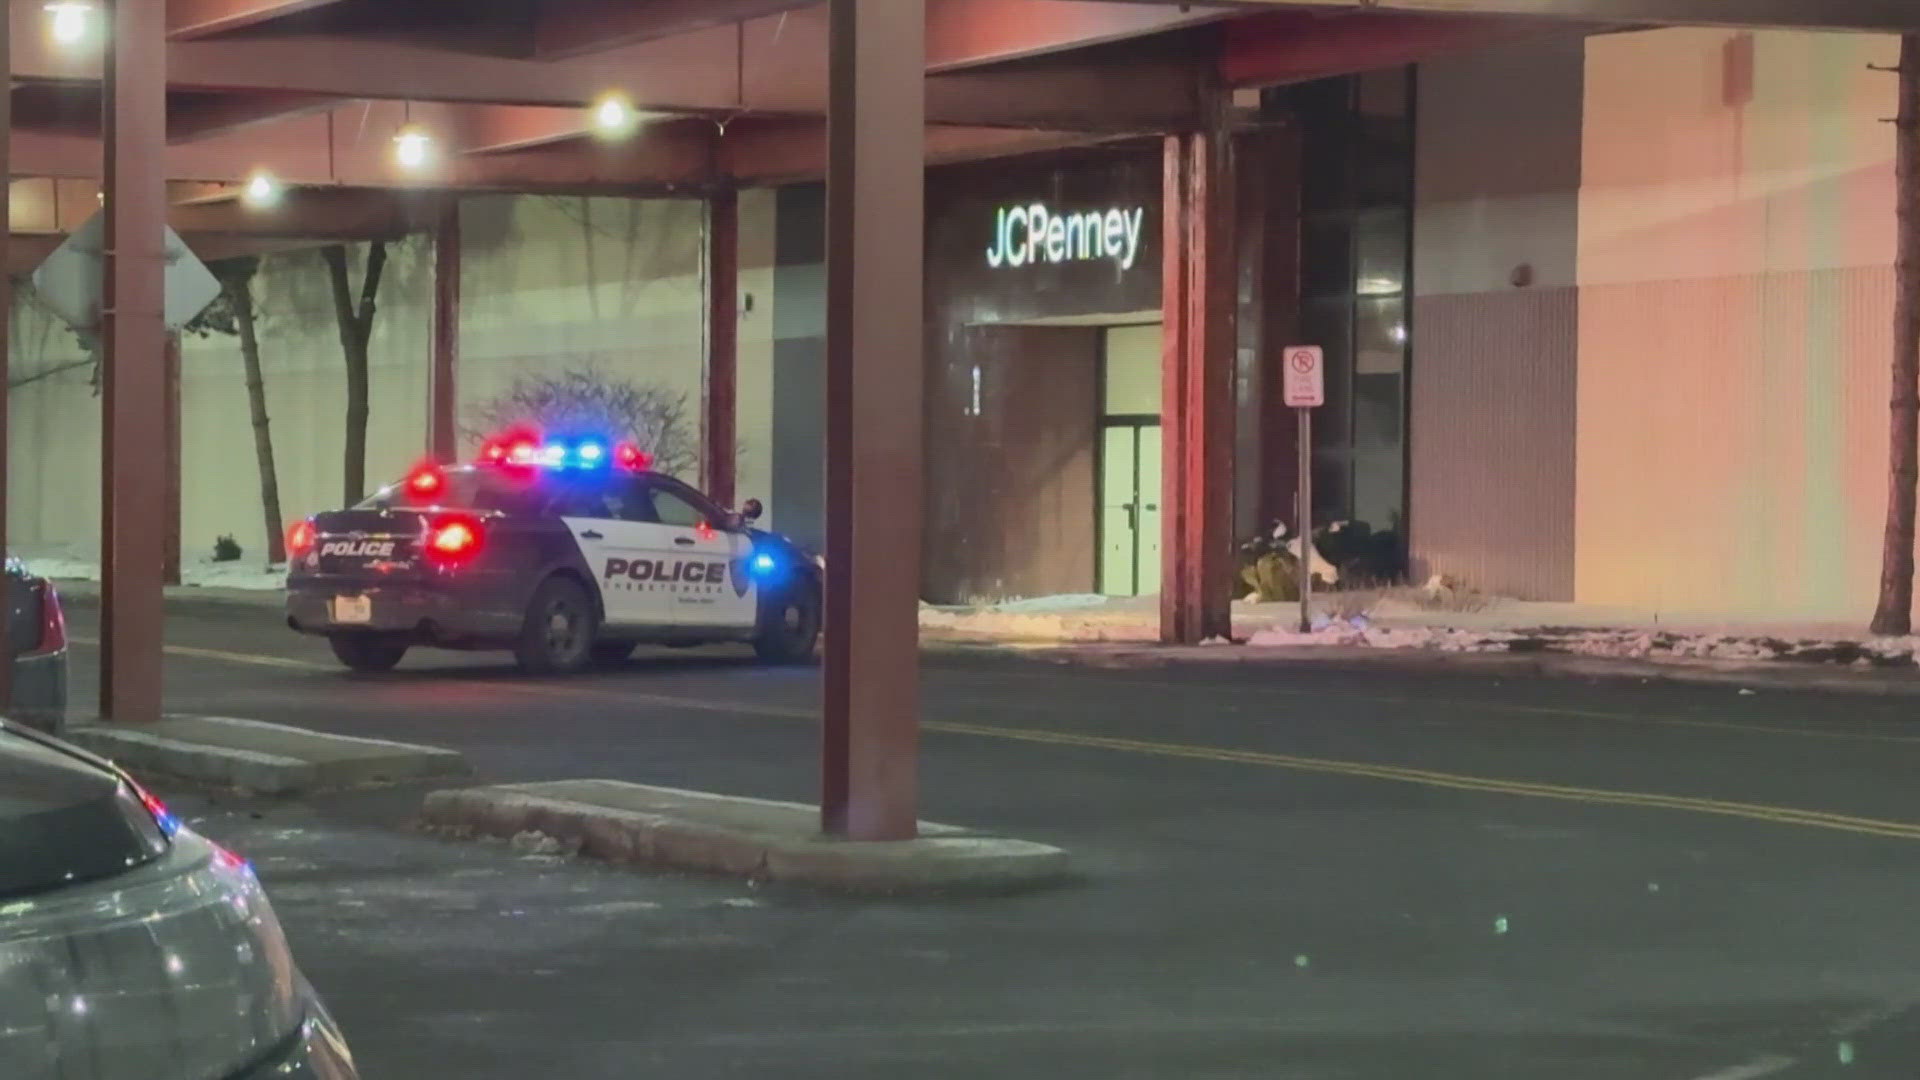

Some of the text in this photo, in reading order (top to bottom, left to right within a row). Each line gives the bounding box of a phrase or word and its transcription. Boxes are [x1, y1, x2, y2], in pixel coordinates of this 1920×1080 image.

[987, 204, 1143, 270] JCPenney
[320, 541, 395, 557] POLICE
[604, 558, 726, 583] POLICE
